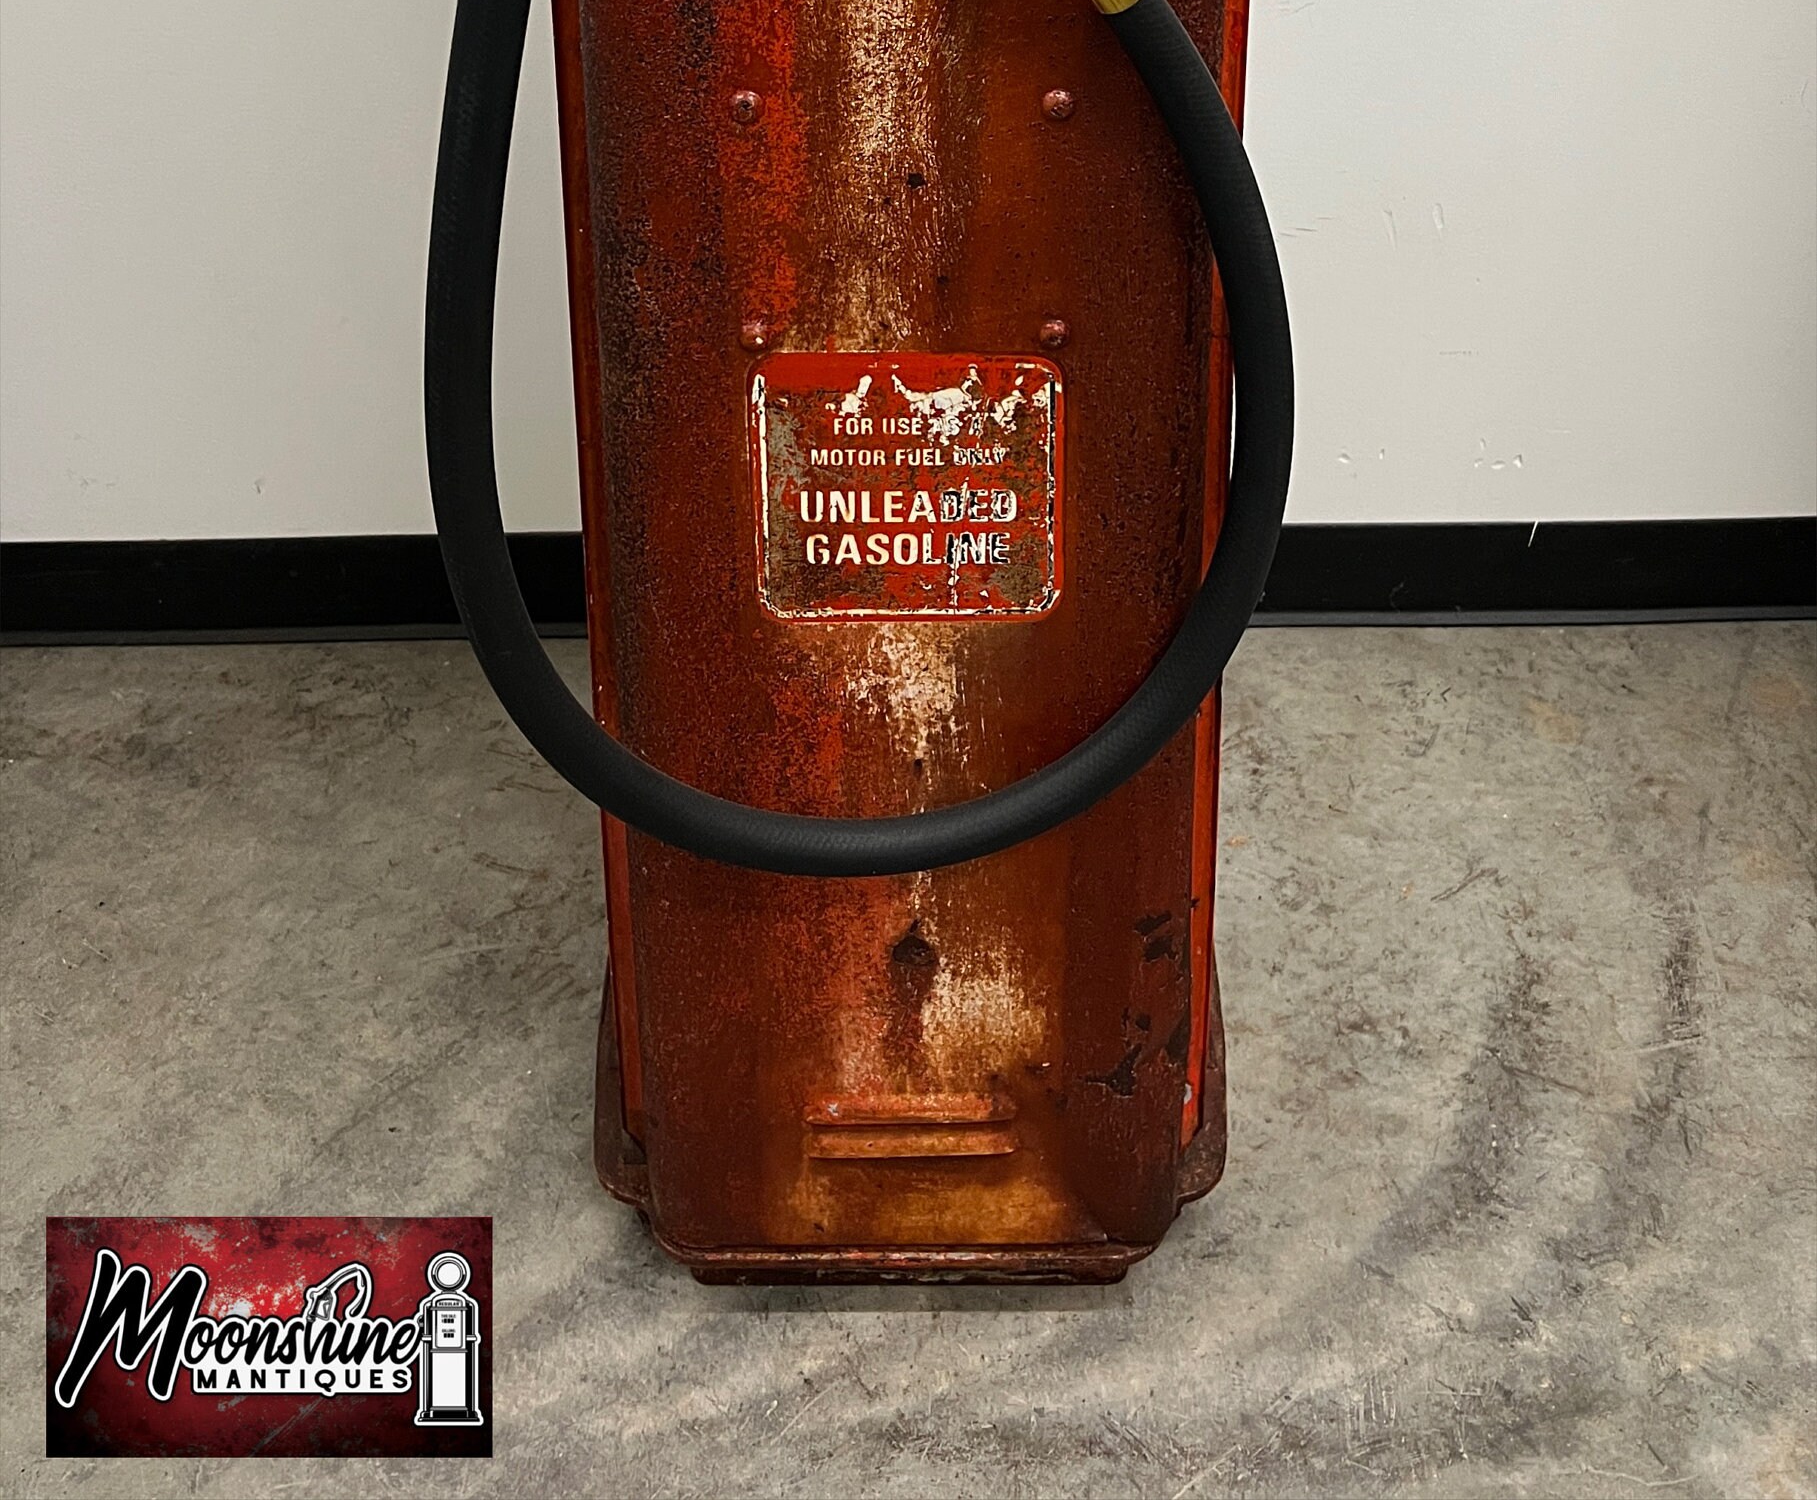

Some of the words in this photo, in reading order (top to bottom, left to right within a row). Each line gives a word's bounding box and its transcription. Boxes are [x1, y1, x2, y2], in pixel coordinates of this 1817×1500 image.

[833, 417, 873, 435] FOR
[882, 417, 922, 435] USE
[810, 448, 886, 466] MOTOR
[895, 448, 945, 466] FUEL
[953, 447, 1007, 467] ONLY
[799, 489, 1018, 523] UNLEADED
[806, 532, 1011, 565] GASOLINE
